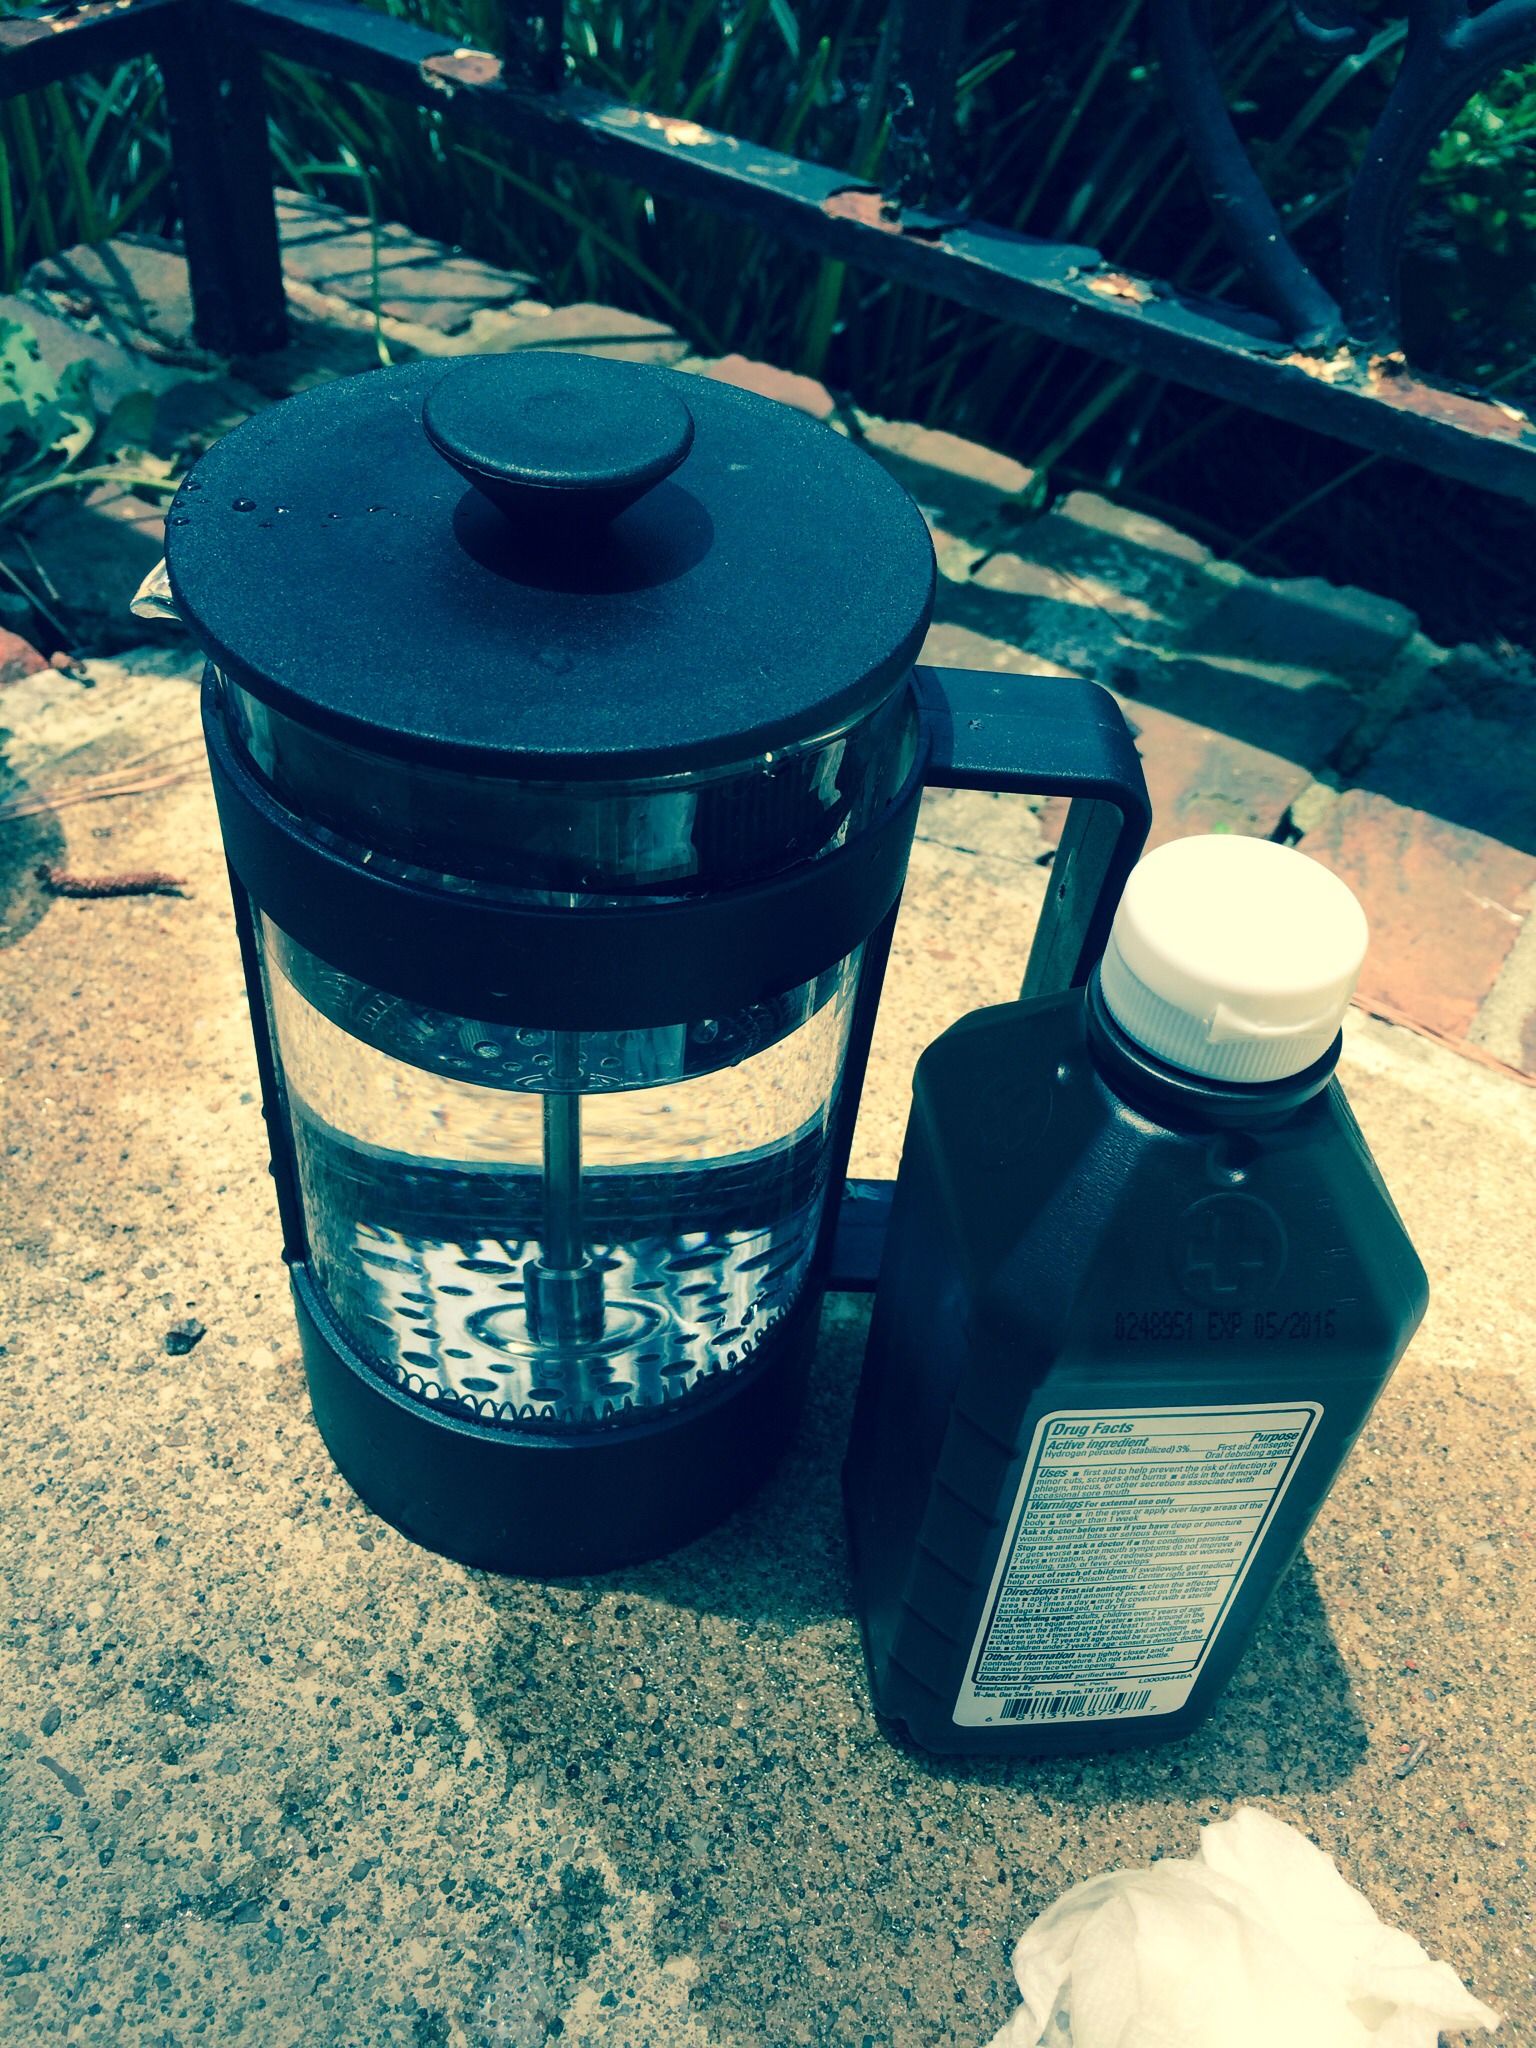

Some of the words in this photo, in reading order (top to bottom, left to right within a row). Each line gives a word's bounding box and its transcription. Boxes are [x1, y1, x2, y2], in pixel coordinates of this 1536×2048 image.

[1208, 1312, 1242, 1340] EXP
[1051, 1424, 1091, 1437] Drug
[1092, 1422, 1135, 1433] Facts
[1250, 1431, 1300, 1443] Purpose
[1047, 1440, 1086, 1449] Active
[1086, 1438, 1149, 1449] ingredient
[1044, 1449, 1087, 1458] Hydrogen
[1088, 1447, 1127, 1457] peroxide
[1127, 1445, 1176, 1455] (stabilized)
[1252, 1441, 1295, 1450] antiseptic
[1224, 1449, 1266, 1458] debriding
[1265, 1448, 1292, 1456] agent
[1039, 1468, 1069, 1477] Uses
[1128, 1467, 1149, 1475] help
[1149, 1465, 1184, 1474] prevent
[1229, 1461, 1268, 1469] infection
[1036, 1477, 1062, 1485] minor
[1086, 1476, 1122, 1484] scrapes
[1142, 1473, 1167, 1481] burns
[1226, 1469, 1262, 1477] removal
[1140, 1480, 1186, 1488] secretions
[1187, 1478, 1235, 1486] associated
[1032, 1491, 1080, 1499] occasional
[1103, 1488, 1130, 1496] mouth
[1030, 1500, 1084, 1511] Warnings
[1100, 1499, 1137, 1507] external
[1154, 1498, 1175, 1506] only
[1143, 1507, 1168, 1515] apply
[1189, 1505, 1212, 1513] large
[1024, 1519, 1046, 1527] body
[1058, 1517, 1086, 1525] longer
[1077, 1525, 1105, 1533] before
[1171, 1521, 1193, 1529] deep
[1204, 1519, 1243, 1528] puncture
[1017, 1544, 1037, 1552] Stop
[1196, 1535, 1230, 1543] persists
[1008, 1572, 1031, 1580] Keep
[1004, 1587, 1059, 1596] Directions
[1022, 1672, 1074, 1681] ingredient
